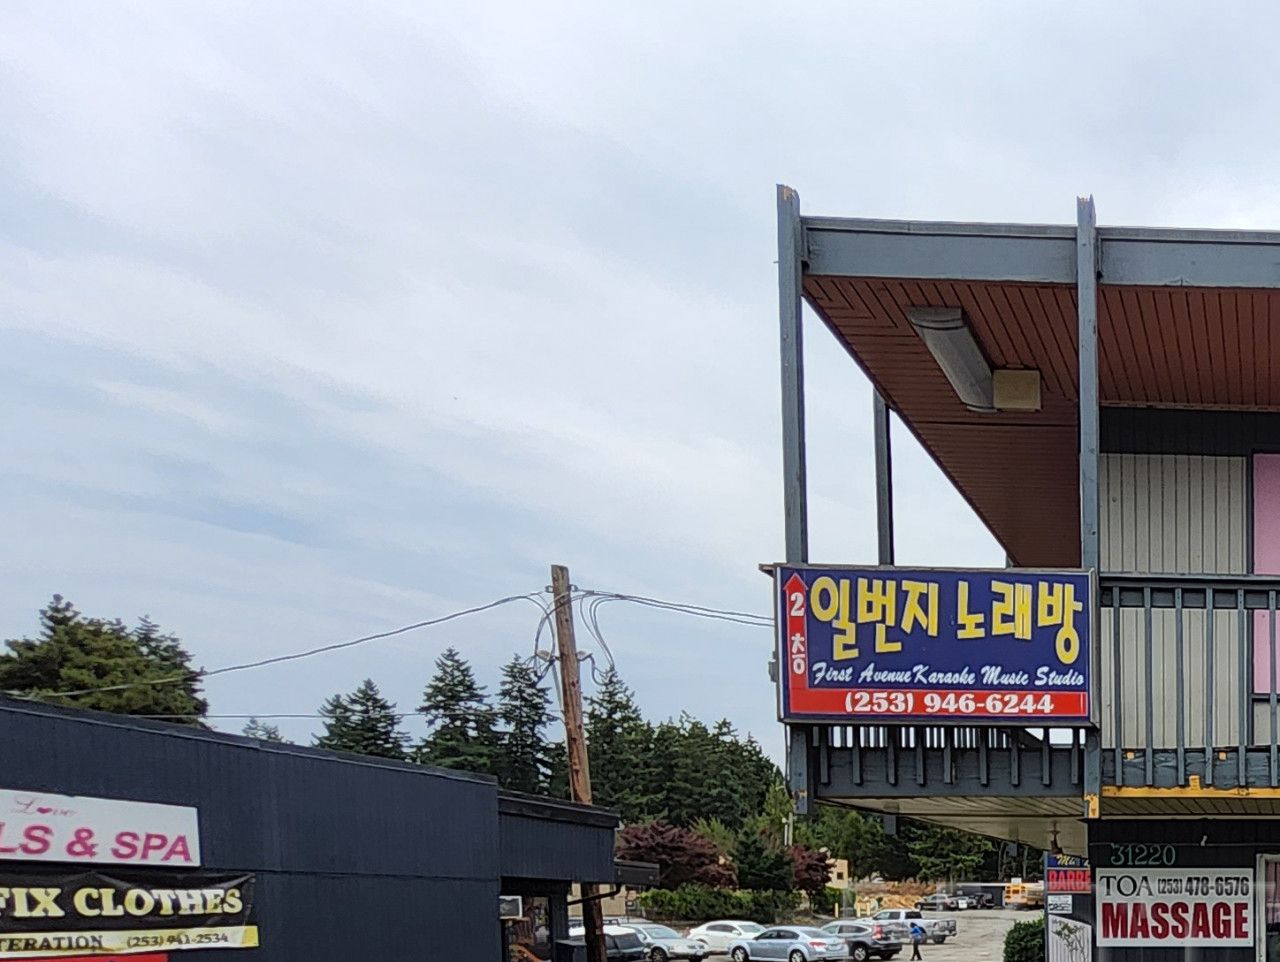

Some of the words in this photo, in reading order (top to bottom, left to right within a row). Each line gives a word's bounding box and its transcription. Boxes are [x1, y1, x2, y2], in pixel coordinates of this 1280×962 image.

[810, 576, 939, 661] 일번지
[956, 580, 1083, 665] 노래방
[812, 662, 853, 684] First
[858, 662, 911, 684] Avenue
[911, 665, 976, 686] Karaoke
[981, 666, 1029, 686] Music
[1034, 667, 1085, 686] Studio
[845, 692, 914, 713] (253)
[924, 692, 1054, 714] 946-6244
[66, 827, 98, 858] &
[110, 830, 193, 862] SPA
[1110, 843, 1176, 865] 31220
[1099, 874, 1154, 897] TOA
[1185, 876, 1250, 897] 478-6576
[73, 888, 243, 917] CLOTHES
[1102, 901, 1249, 939] MASSAGE
[127, 935, 164, 948] (253)
